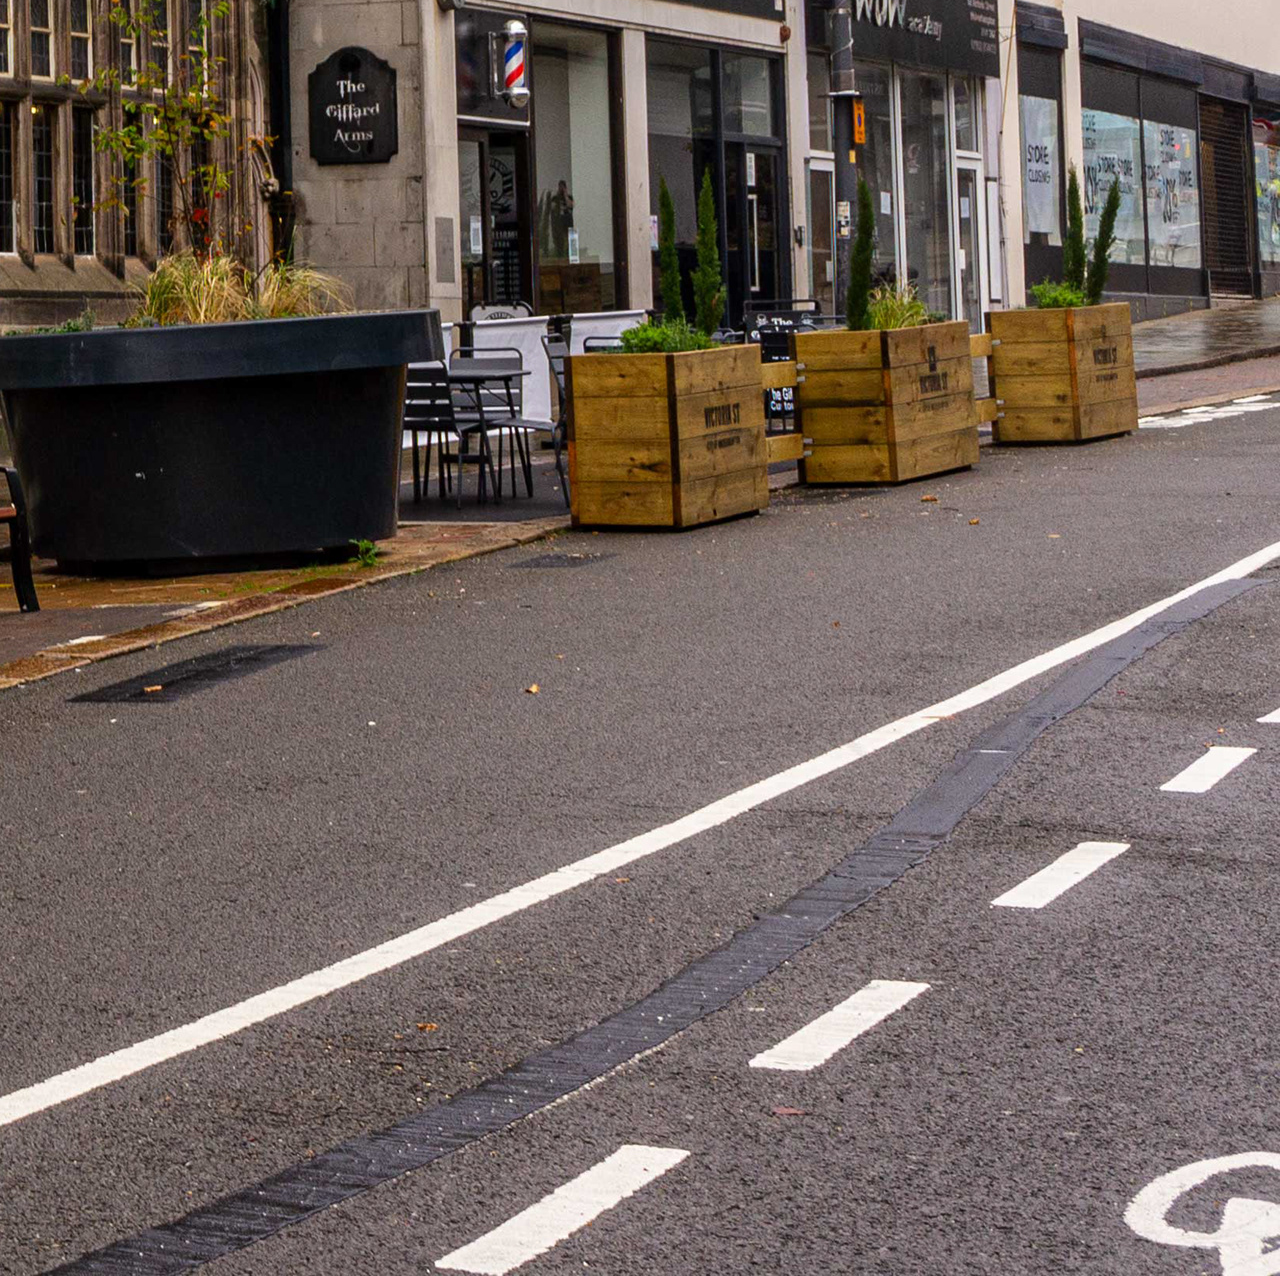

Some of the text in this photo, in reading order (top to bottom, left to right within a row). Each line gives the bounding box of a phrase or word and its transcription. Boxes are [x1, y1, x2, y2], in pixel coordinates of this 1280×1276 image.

[336, 78, 366, 98] The
[326, 103, 380, 123] Giffard
[334, 129, 374, 147] Arms
